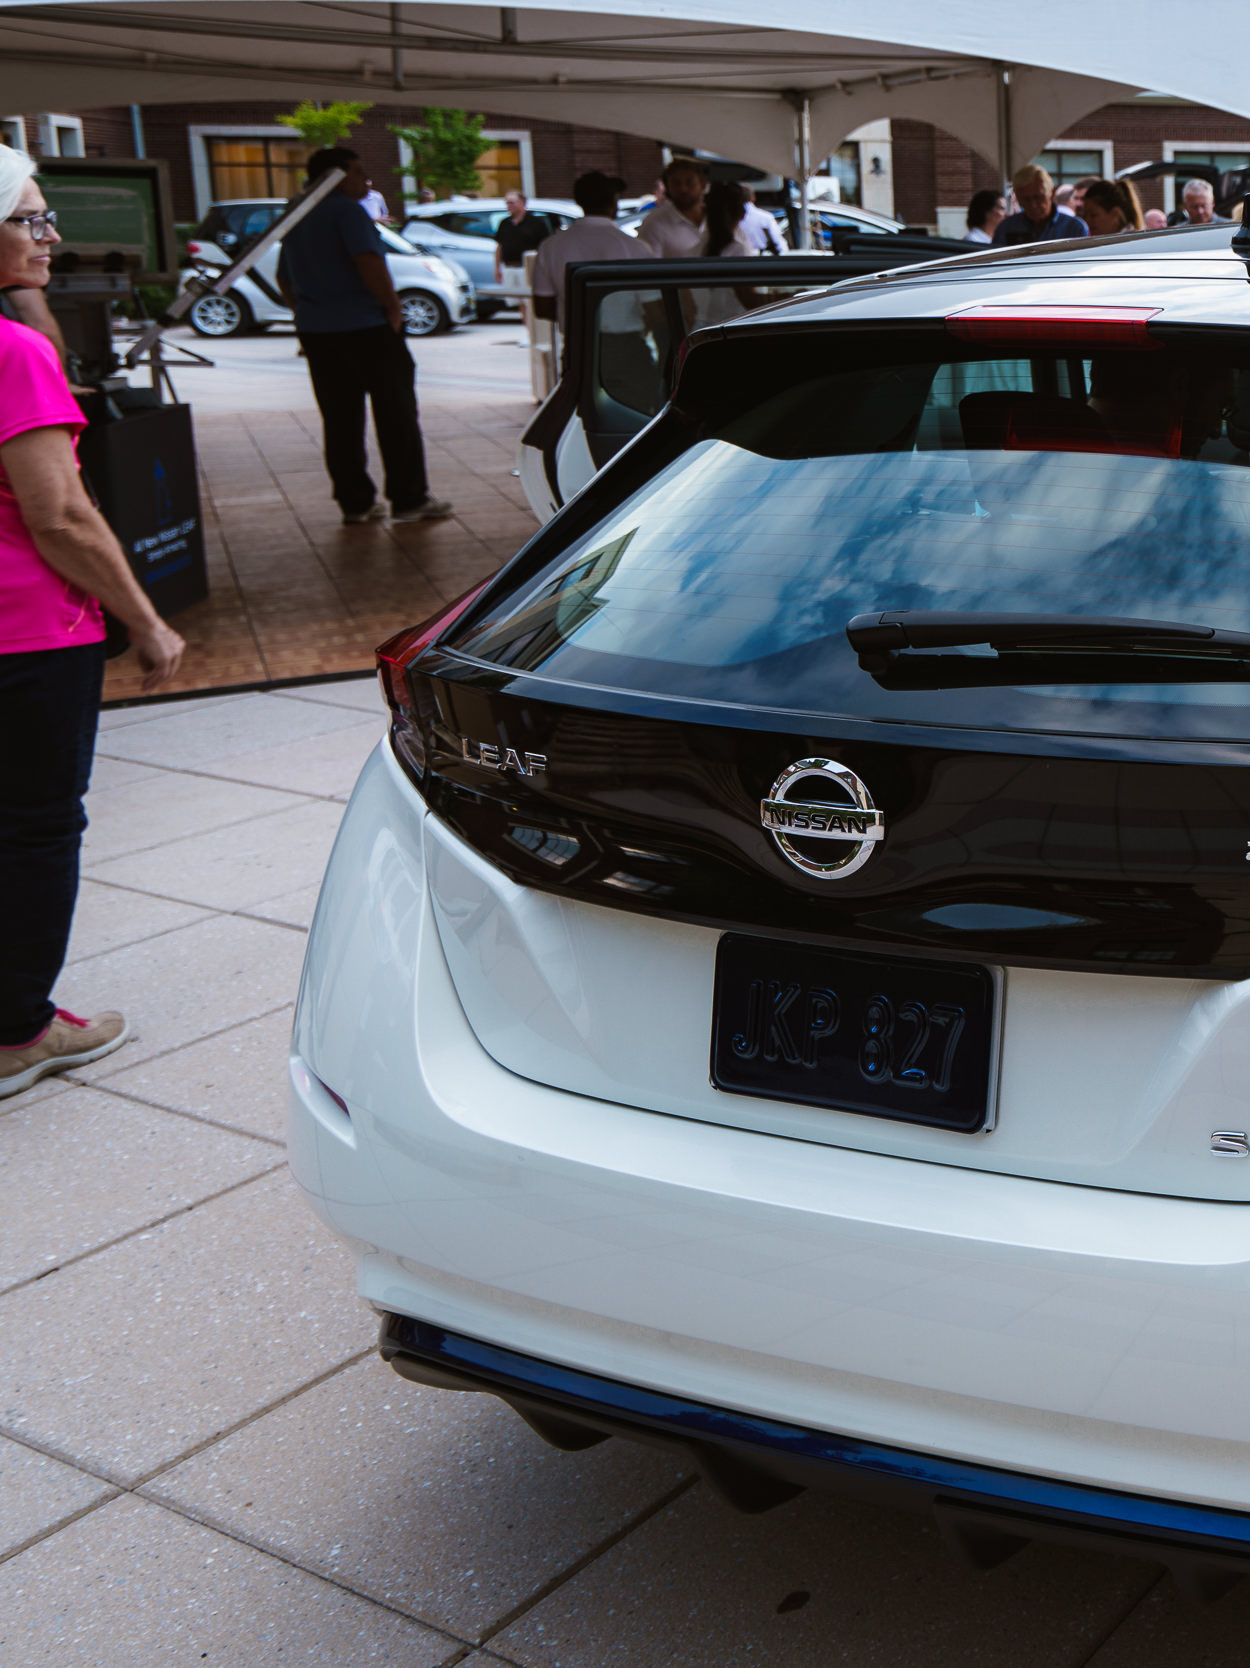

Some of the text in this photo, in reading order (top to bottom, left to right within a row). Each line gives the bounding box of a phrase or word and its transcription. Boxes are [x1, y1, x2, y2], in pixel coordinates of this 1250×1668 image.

[461, 737, 547, 776] LEAF
[769, 807, 868, 835] NISSAN
[732, 979, 966, 1092] JKP 827
